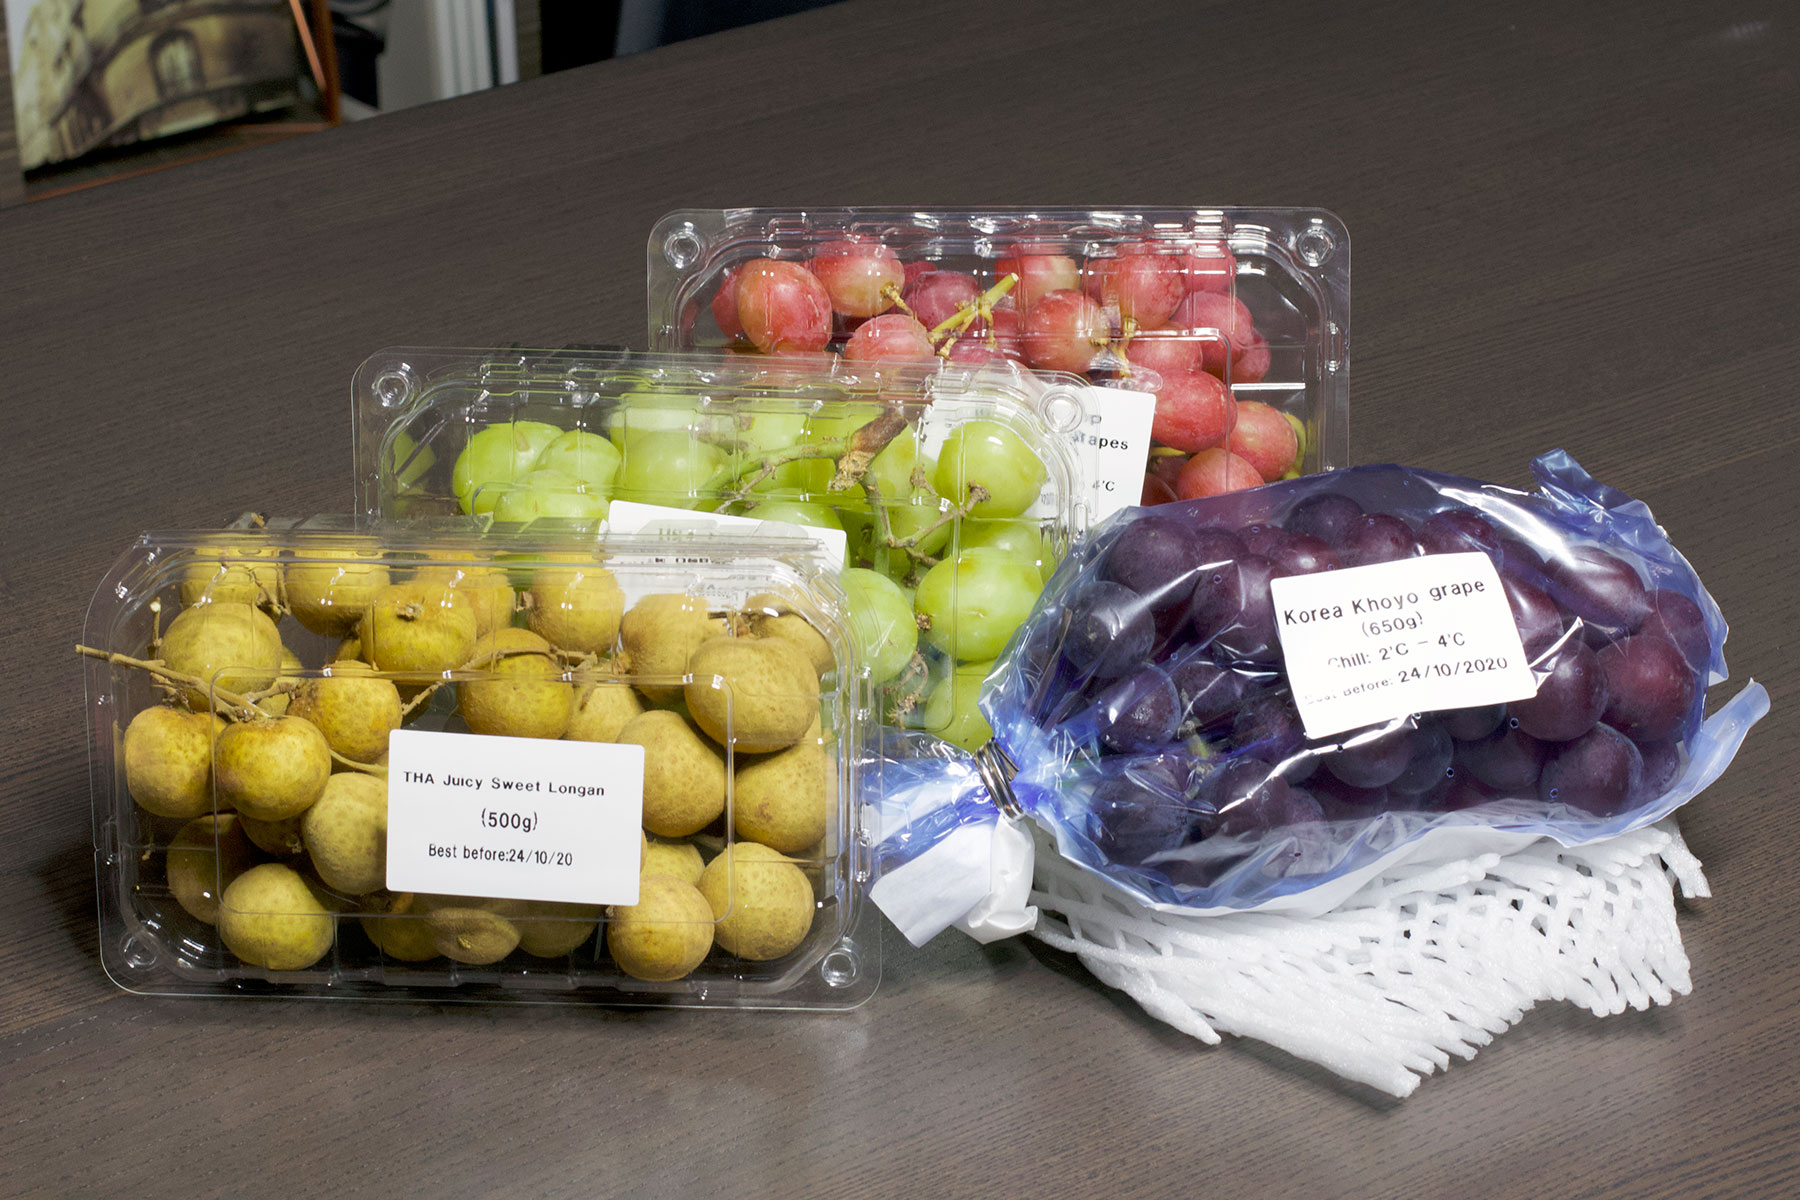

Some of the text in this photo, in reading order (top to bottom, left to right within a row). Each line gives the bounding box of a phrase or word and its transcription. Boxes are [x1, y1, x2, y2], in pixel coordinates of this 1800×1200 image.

[1070, 432, 1128, 450] rapes
[1284, 580, 1485, 625] Korea Khoyo grape
[1362, 611, 1423, 637] (650g)
[1398, 657, 1508, 683] 24/10/2020
[404, 771, 605, 798] THA Juicy Sweet Longan
[481, 807, 538, 833] (500g)
[428, 843, 457, 859] Best
